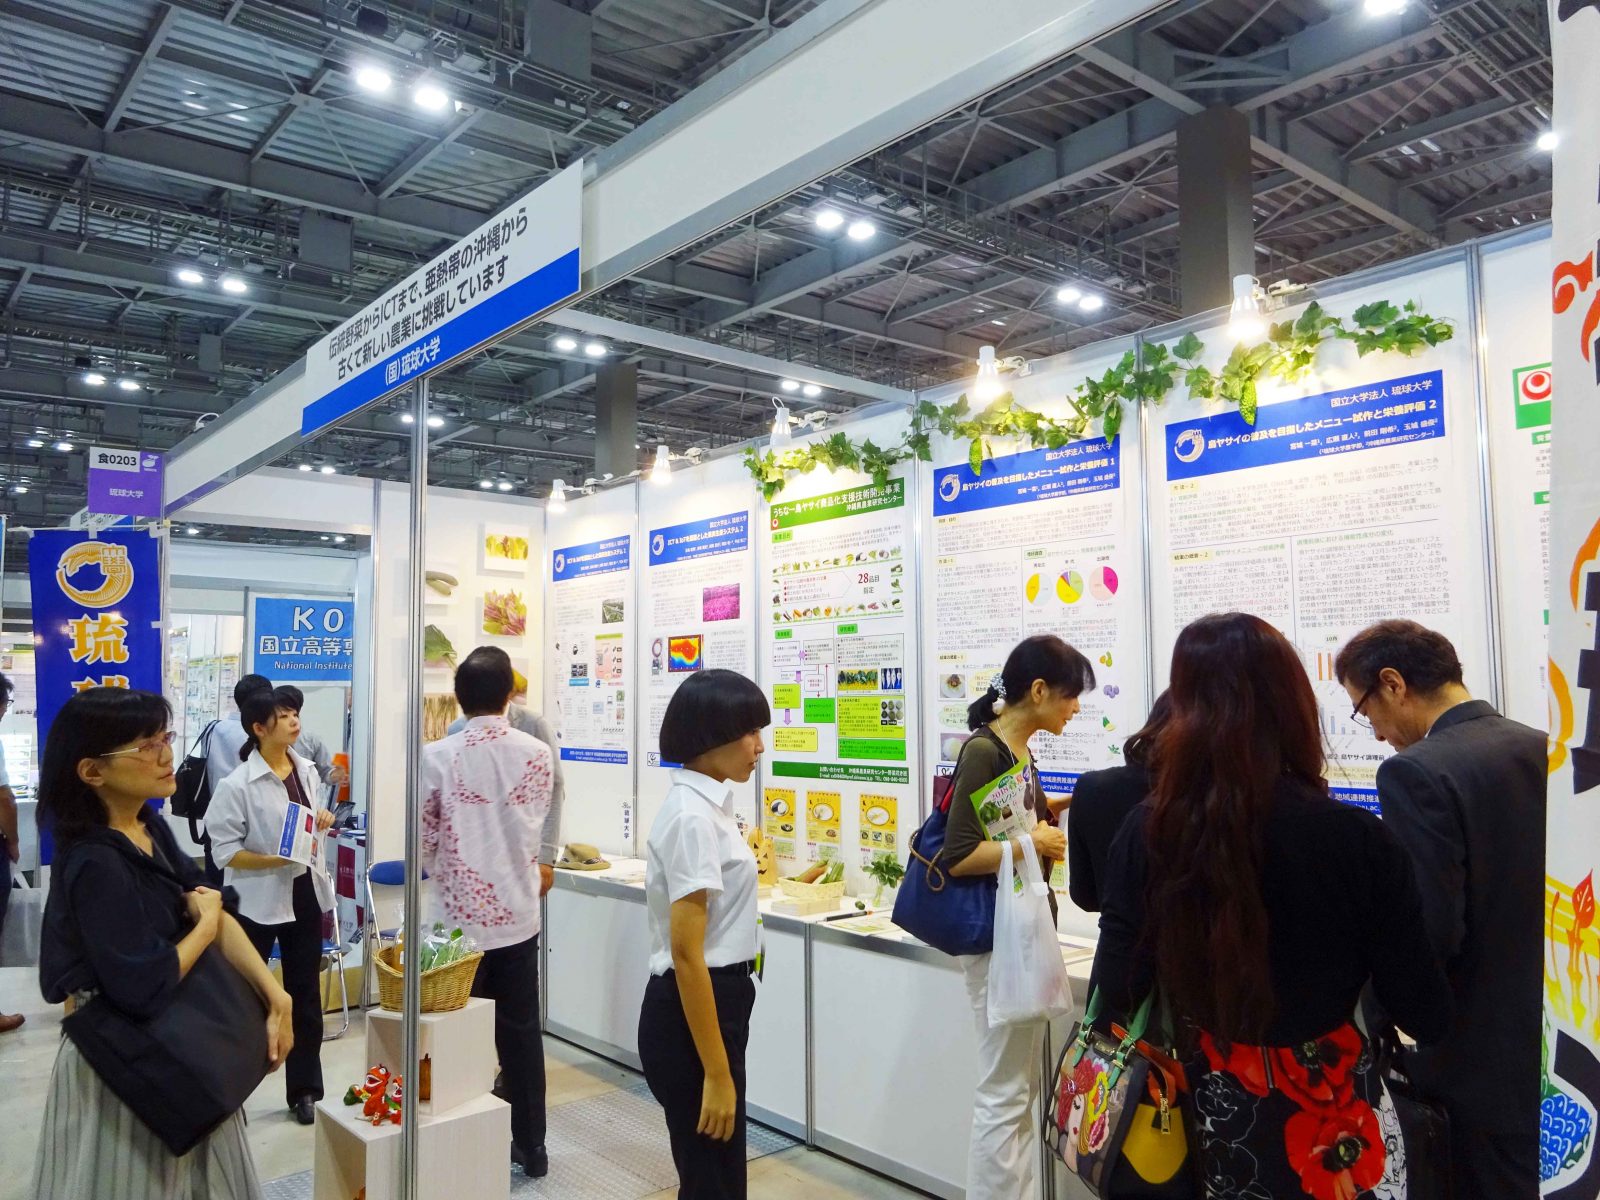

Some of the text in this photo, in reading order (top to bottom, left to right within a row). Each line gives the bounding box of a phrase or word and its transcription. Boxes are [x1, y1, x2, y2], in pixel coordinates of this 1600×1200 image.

[329, 207, 528, 361] 伝統野菜からICTまで、亜熱帯の沖縄から
[338, 255, 509, 381] 古くて新しい農業に挑戦しています
[1331, 379, 1432, 407] 国立大学法人 琉球大学
[1429, 400, 1436, 409] 2
[98, 453, 137, 466] 食0203
[274, 661, 352, 670] National Institute
